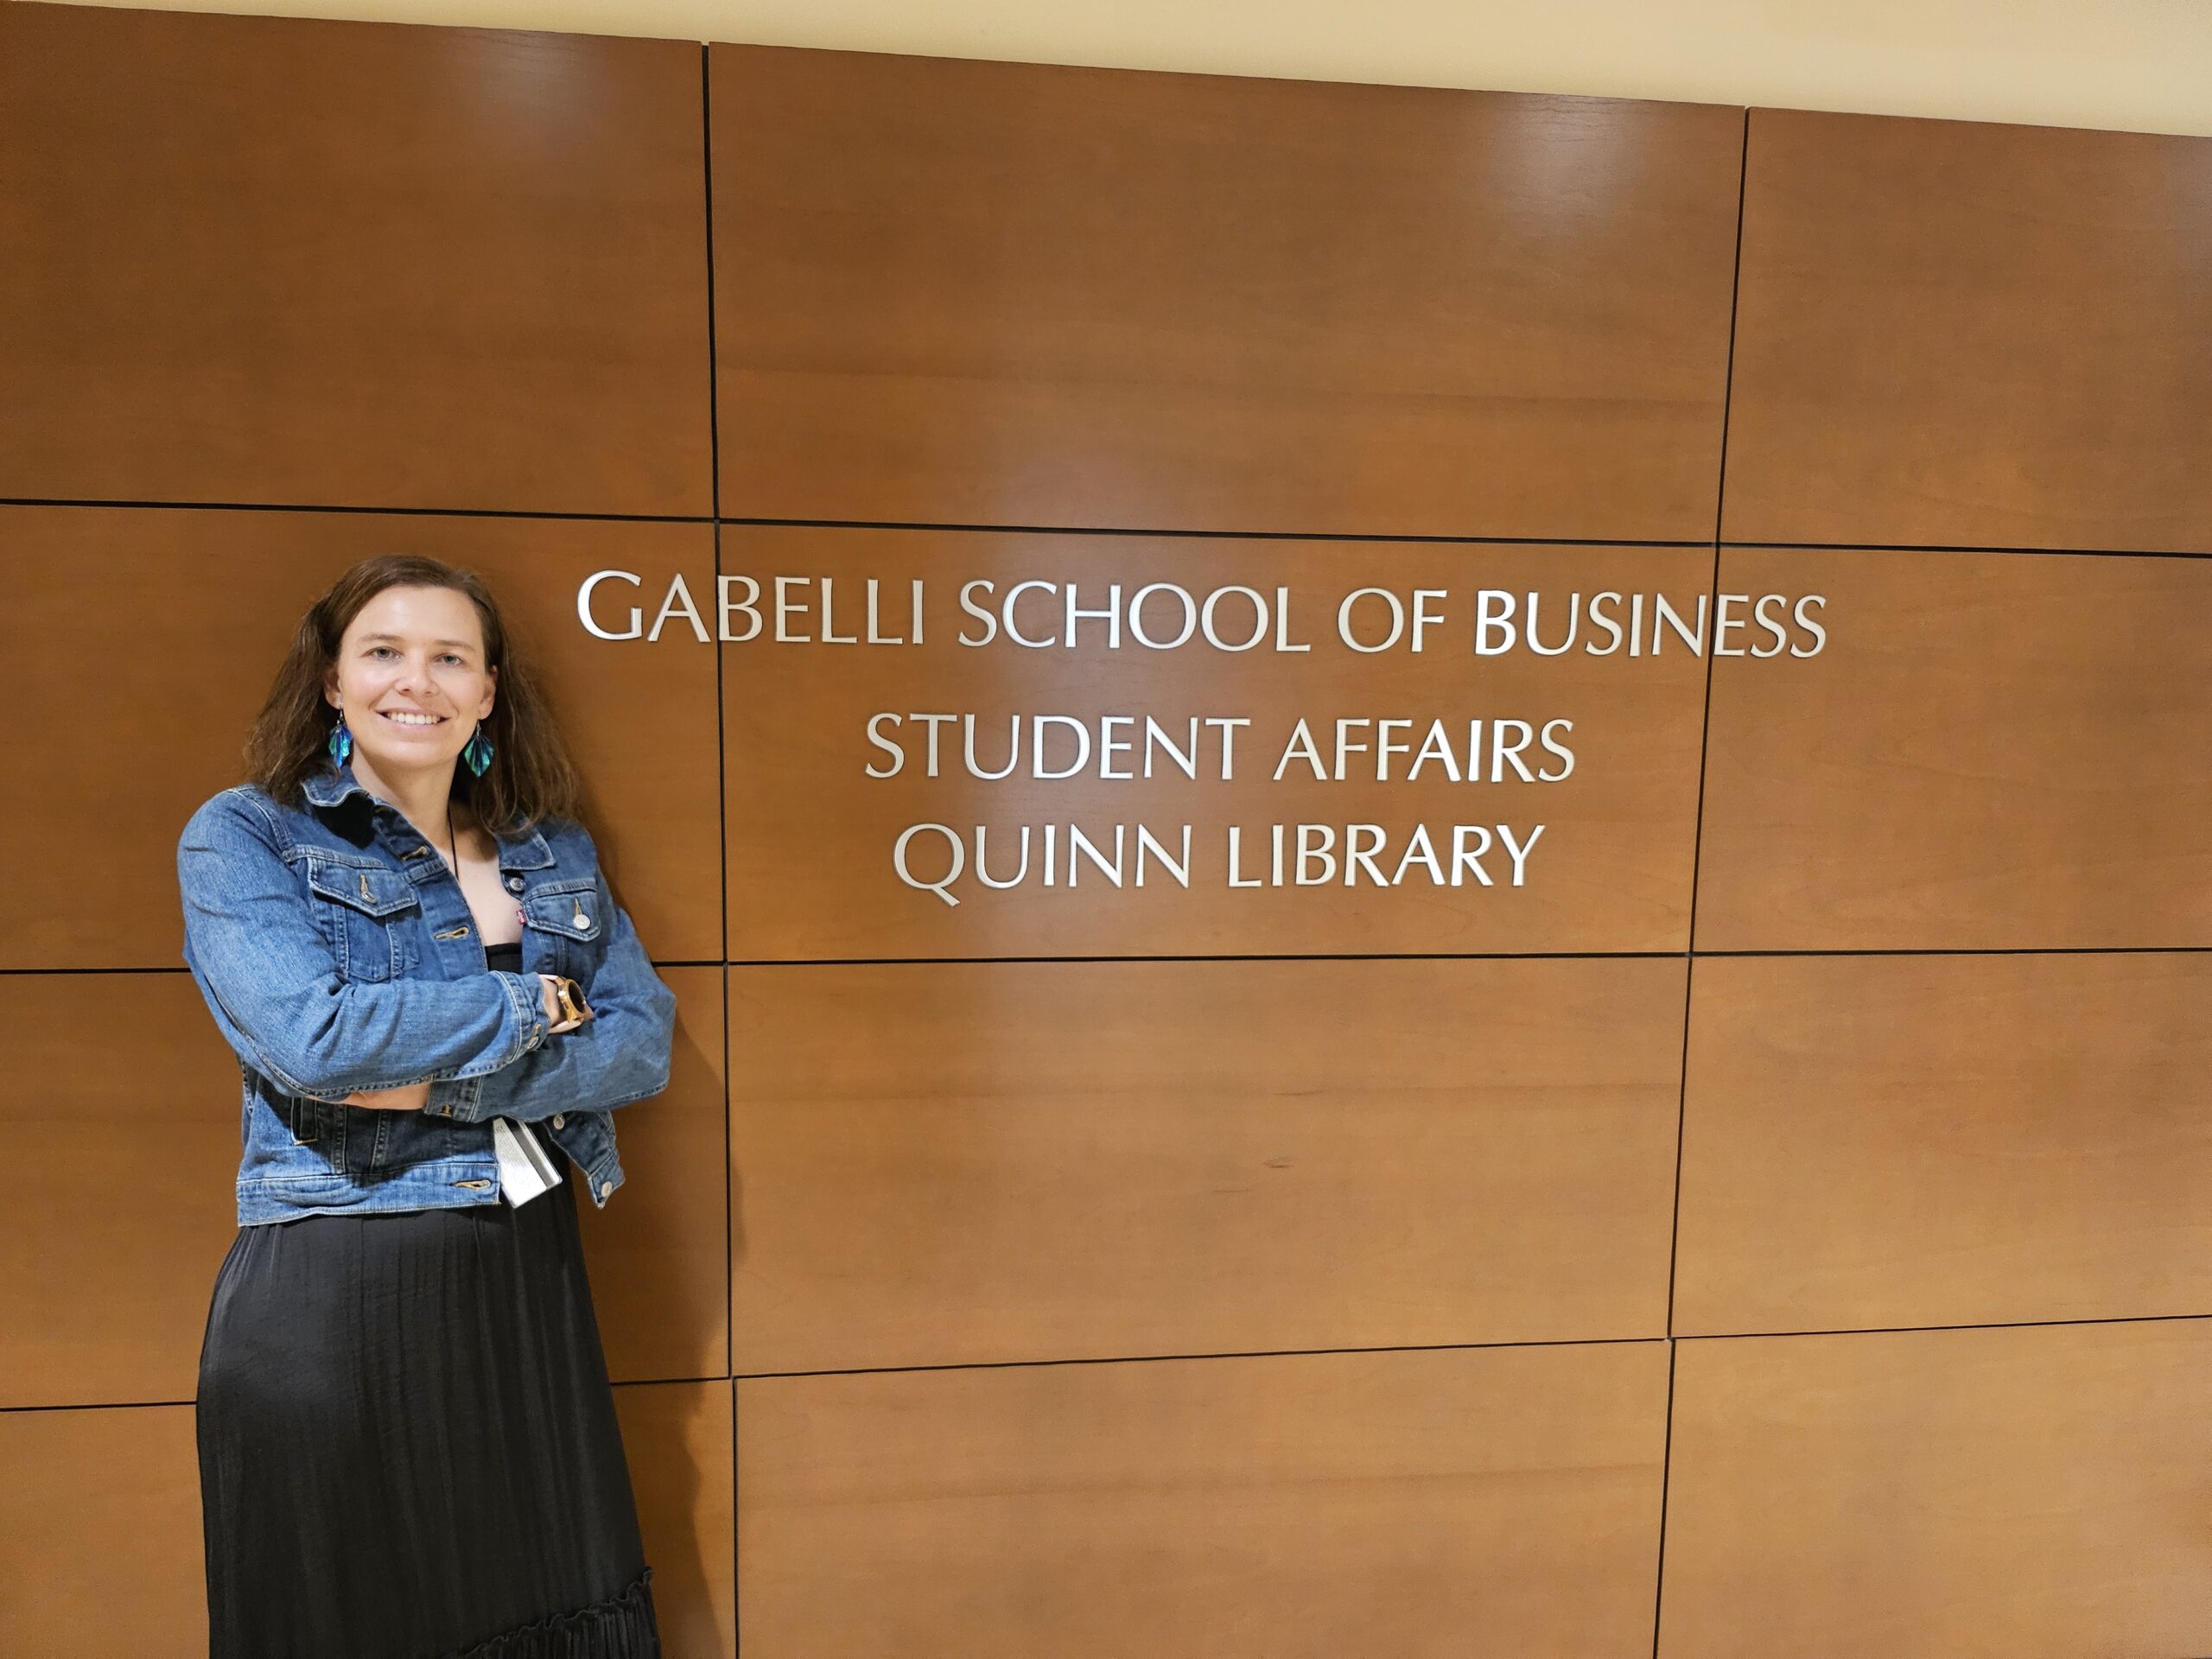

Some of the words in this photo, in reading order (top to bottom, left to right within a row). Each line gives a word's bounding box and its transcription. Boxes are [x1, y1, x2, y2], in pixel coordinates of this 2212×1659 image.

[576, 569, 925, 645] GABELLI
[958, 579, 1312, 653] SCHOOL
[1337, 588, 1448, 653] OF
[1474, 589, 1827, 659] BUSINESS
[865, 713, 1252, 781] STUDENT
[1272, 717, 1576, 783] AFFAIRS
[893, 823, 1193, 908] QUINN
[1227, 823, 1546, 889] LIBRARY
